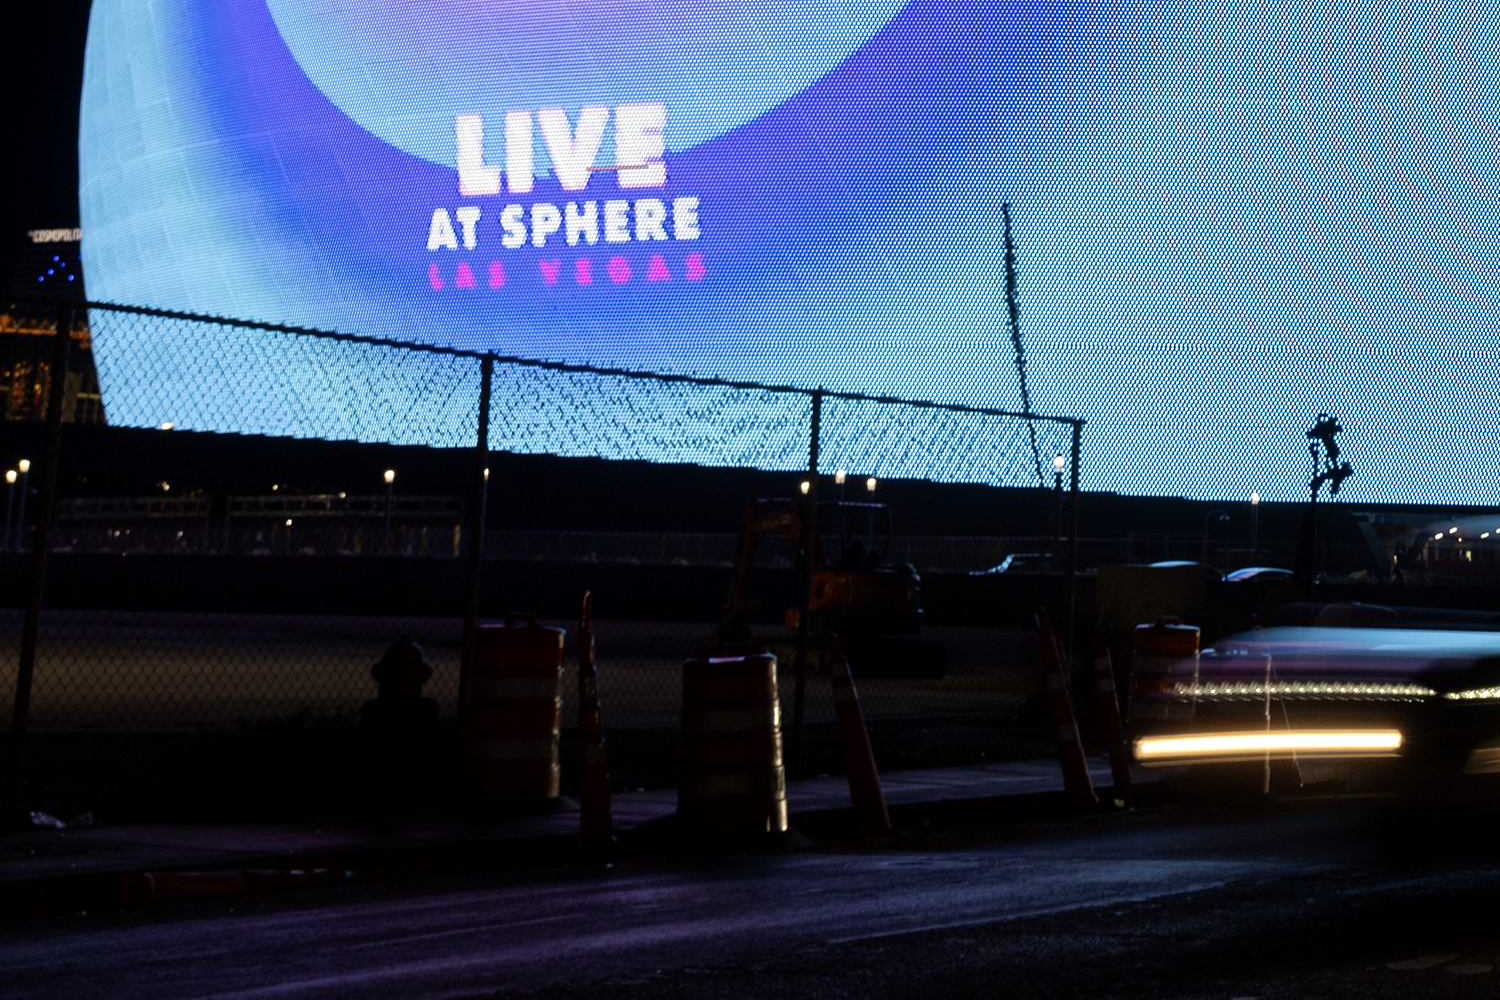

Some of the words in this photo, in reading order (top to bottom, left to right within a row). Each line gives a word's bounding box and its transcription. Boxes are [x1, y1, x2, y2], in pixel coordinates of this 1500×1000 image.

[455, 101, 668, 196] LIVE
[426, 206, 482, 250] AT
[500, 196, 701, 250] SPHERE
[428, 261, 507, 290] LAS
[538, 254, 707, 286] VEGAS
